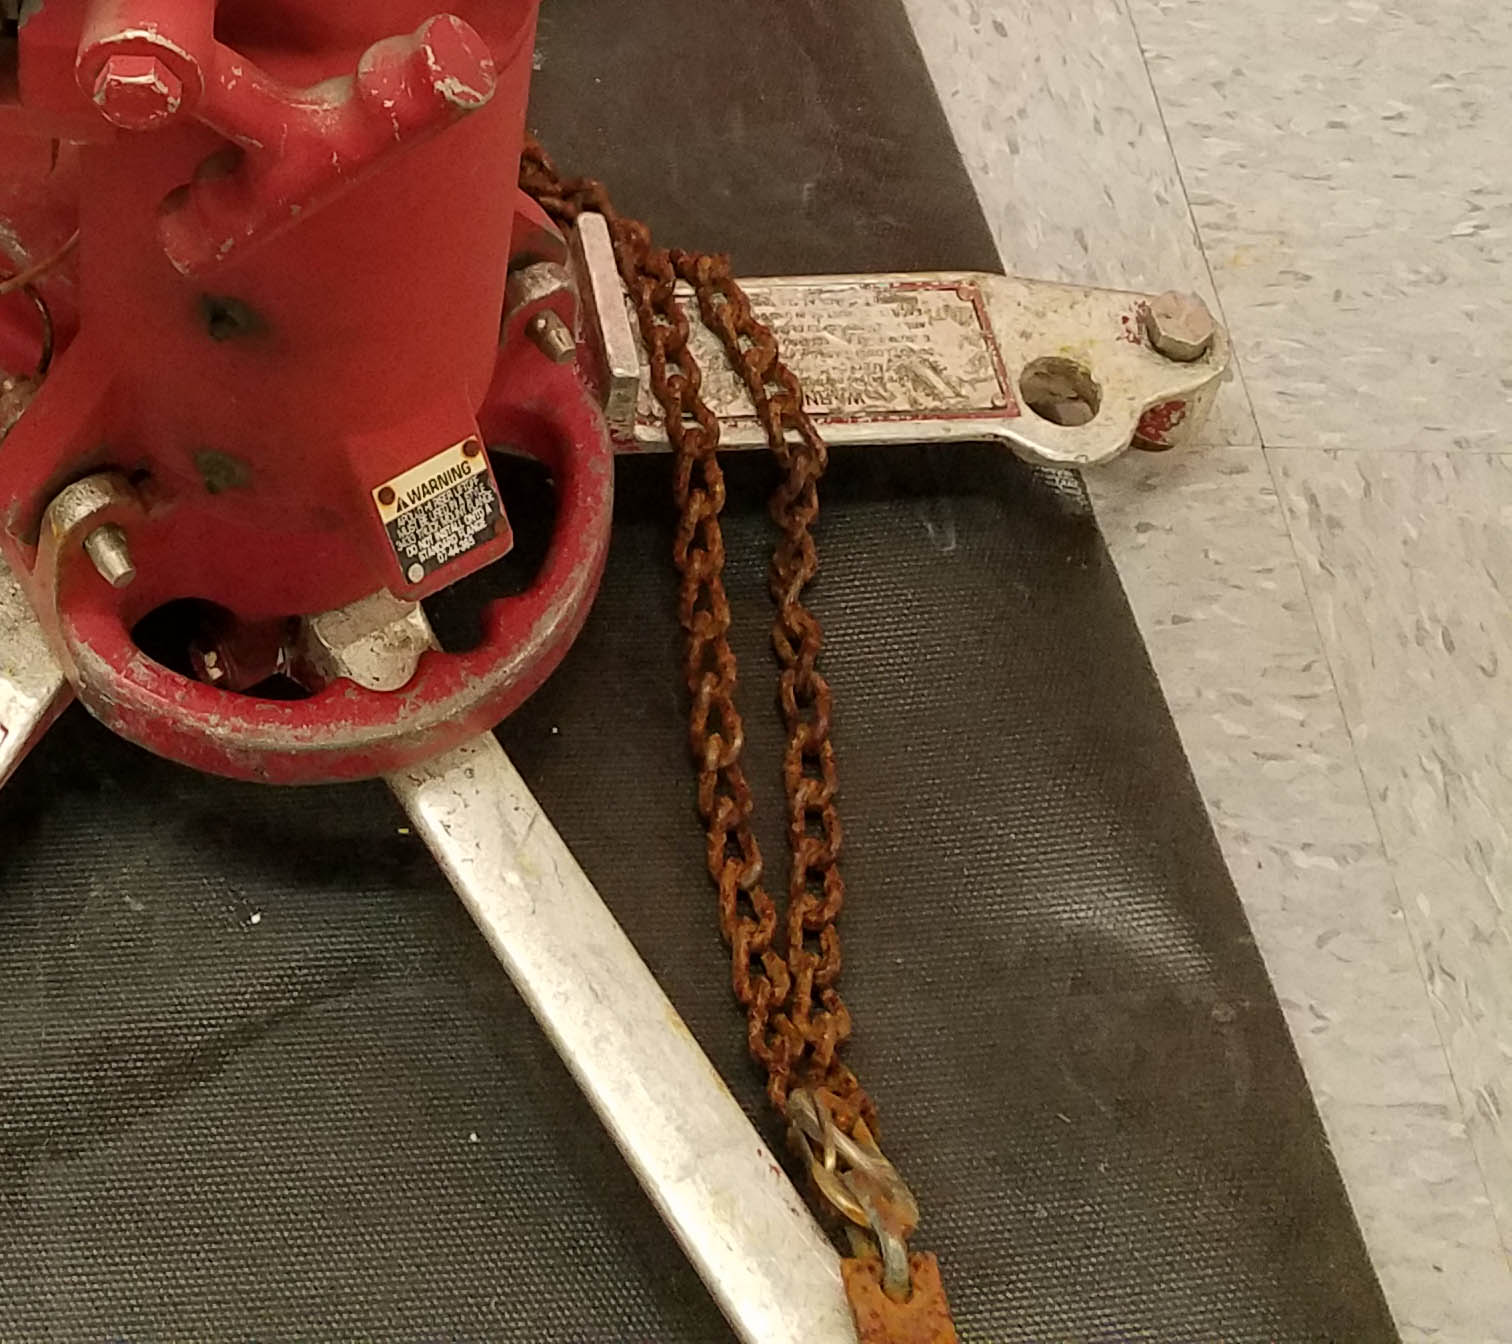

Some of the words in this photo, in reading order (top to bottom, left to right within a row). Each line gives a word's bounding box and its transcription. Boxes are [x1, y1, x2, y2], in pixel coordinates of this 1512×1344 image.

[405, 458, 473, 505] WARNING
[404, 543, 419, 558] DO
[416, 533, 435, 550] NOT
